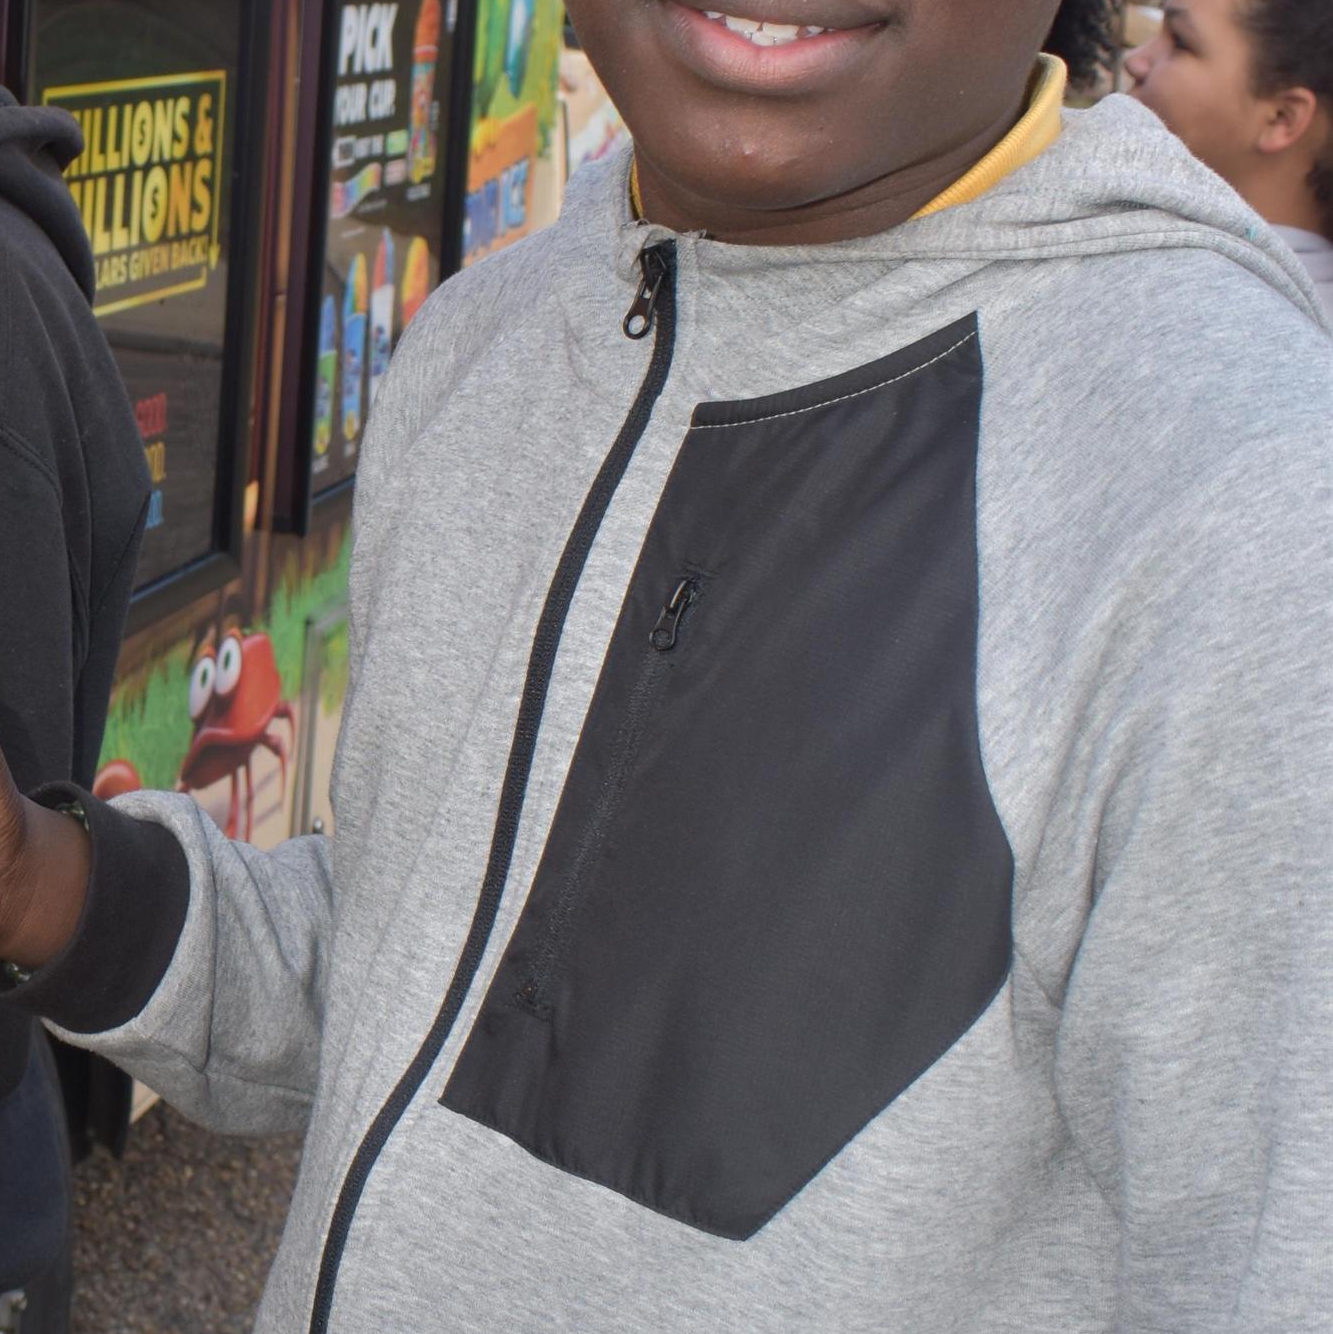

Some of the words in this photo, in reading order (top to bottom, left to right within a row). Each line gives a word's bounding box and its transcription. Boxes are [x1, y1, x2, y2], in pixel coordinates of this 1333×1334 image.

[337, 2, 399, 77] PICK
[193, 93, 213, 155] &
[129, 243, 170, 281] GIVEN
